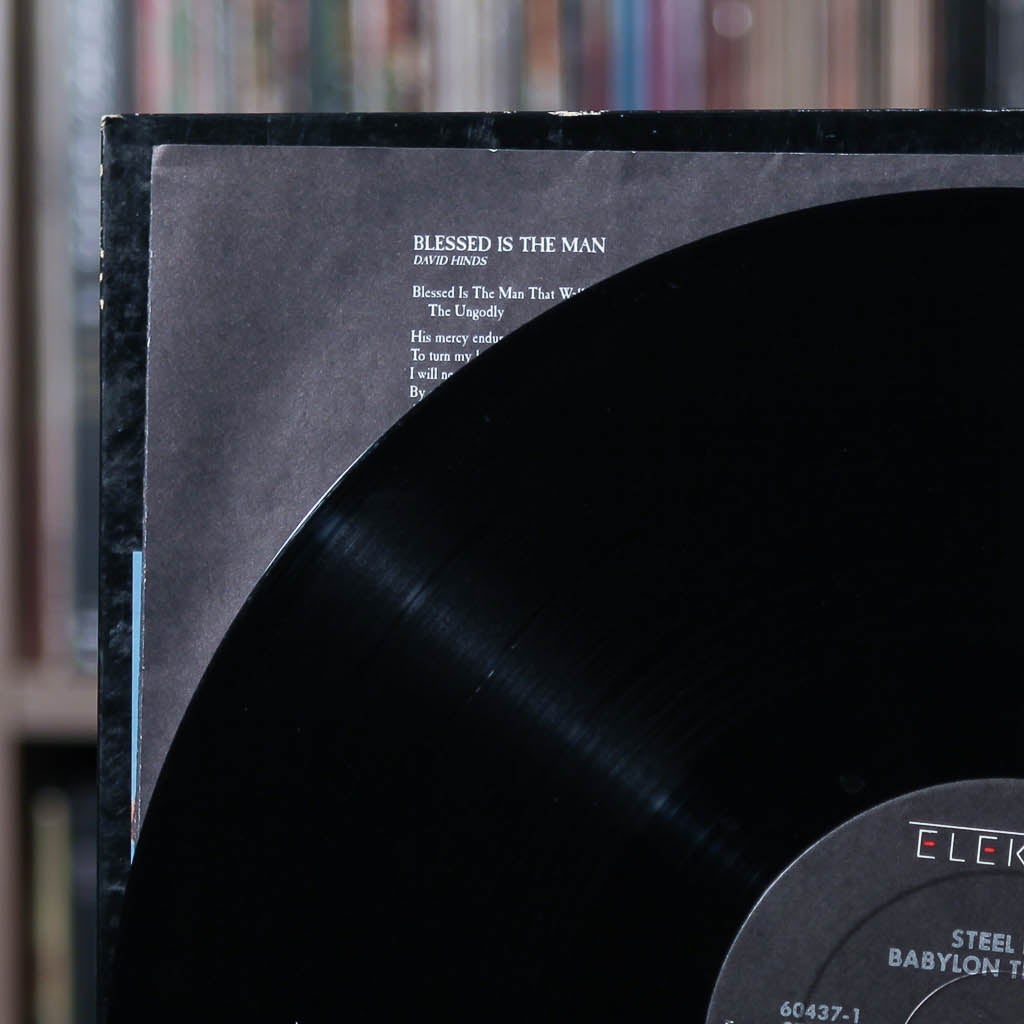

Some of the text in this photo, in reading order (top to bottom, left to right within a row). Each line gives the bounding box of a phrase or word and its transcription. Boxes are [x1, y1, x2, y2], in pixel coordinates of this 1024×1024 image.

[414, 235, 606, 253] BLESSED IS THE MAN
[414, 255, 488, 266] DAVID HINDS
[412, 286, 455, 298] Blessed
[459, 287, 468, 299] Is
[472, 287, 495, 299] The
[499, 287, 524, 299] Man
[529, 287, 555, 299] That
[428, 304, 504, 320] The Ungodly
[411, 330, 431, 343] His
[435, 333, 469, 347] mercy
[411, 349, 425, 361] To
[429, 350, 450, 361] turn
[454, 352, 472, 363] my
[410, 367, 415, 379] I
[417, 367, 438, 380] will
[410, 385, 425, 399] By
[952, 929, 1014, 954] STEEL
[888, 947, 1000, 977] BABYLON
[780, 1000, 860, 1024] 60437-1
